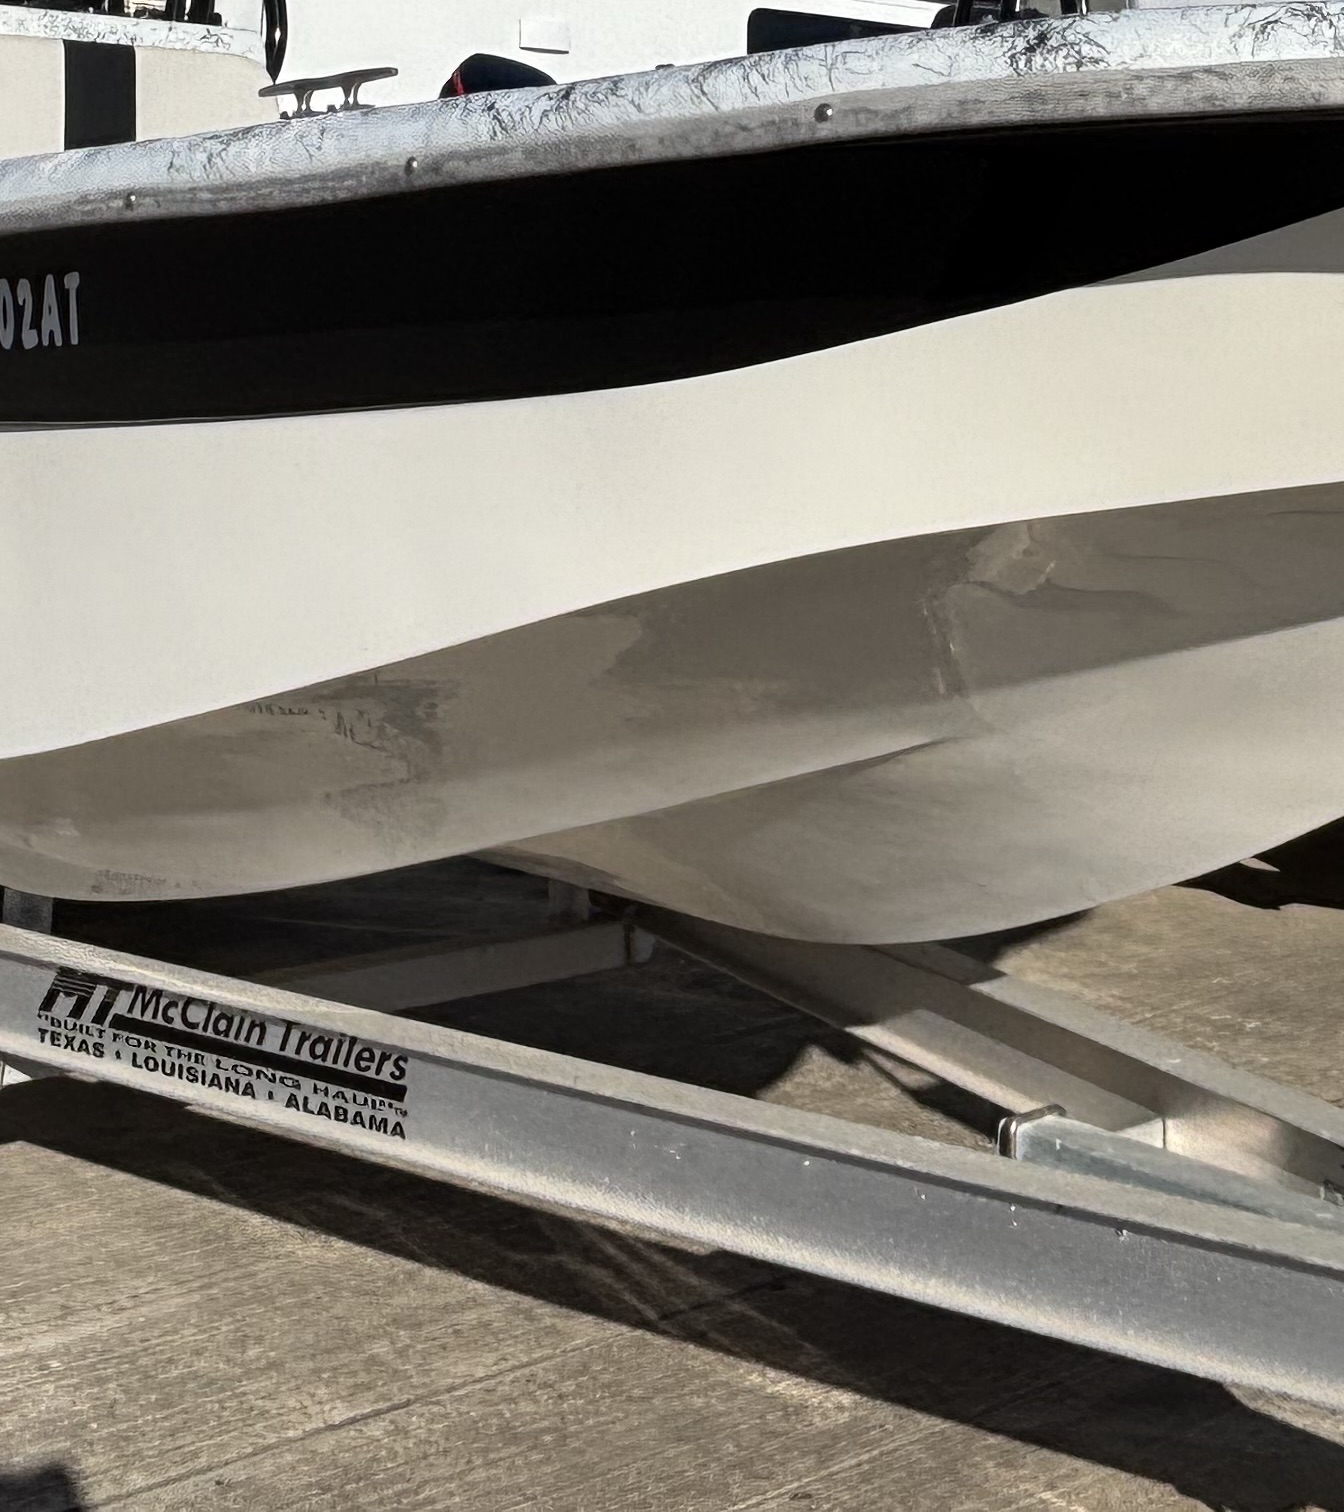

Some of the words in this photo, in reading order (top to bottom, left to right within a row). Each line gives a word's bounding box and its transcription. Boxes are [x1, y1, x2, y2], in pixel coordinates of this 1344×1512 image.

[112, 1032, 158, 1054] FOR
[215, 1057, 302, 1091] LONG
[126, 984, 267, 1046] McClain
[279, 1020, 409, 1082] Trailers
[37, 1027, 106, 1059] TEXAS
[131, 1051, 257, 1100] LOUISIANA
[284, 1092, 408, 1141] ALABAMA
